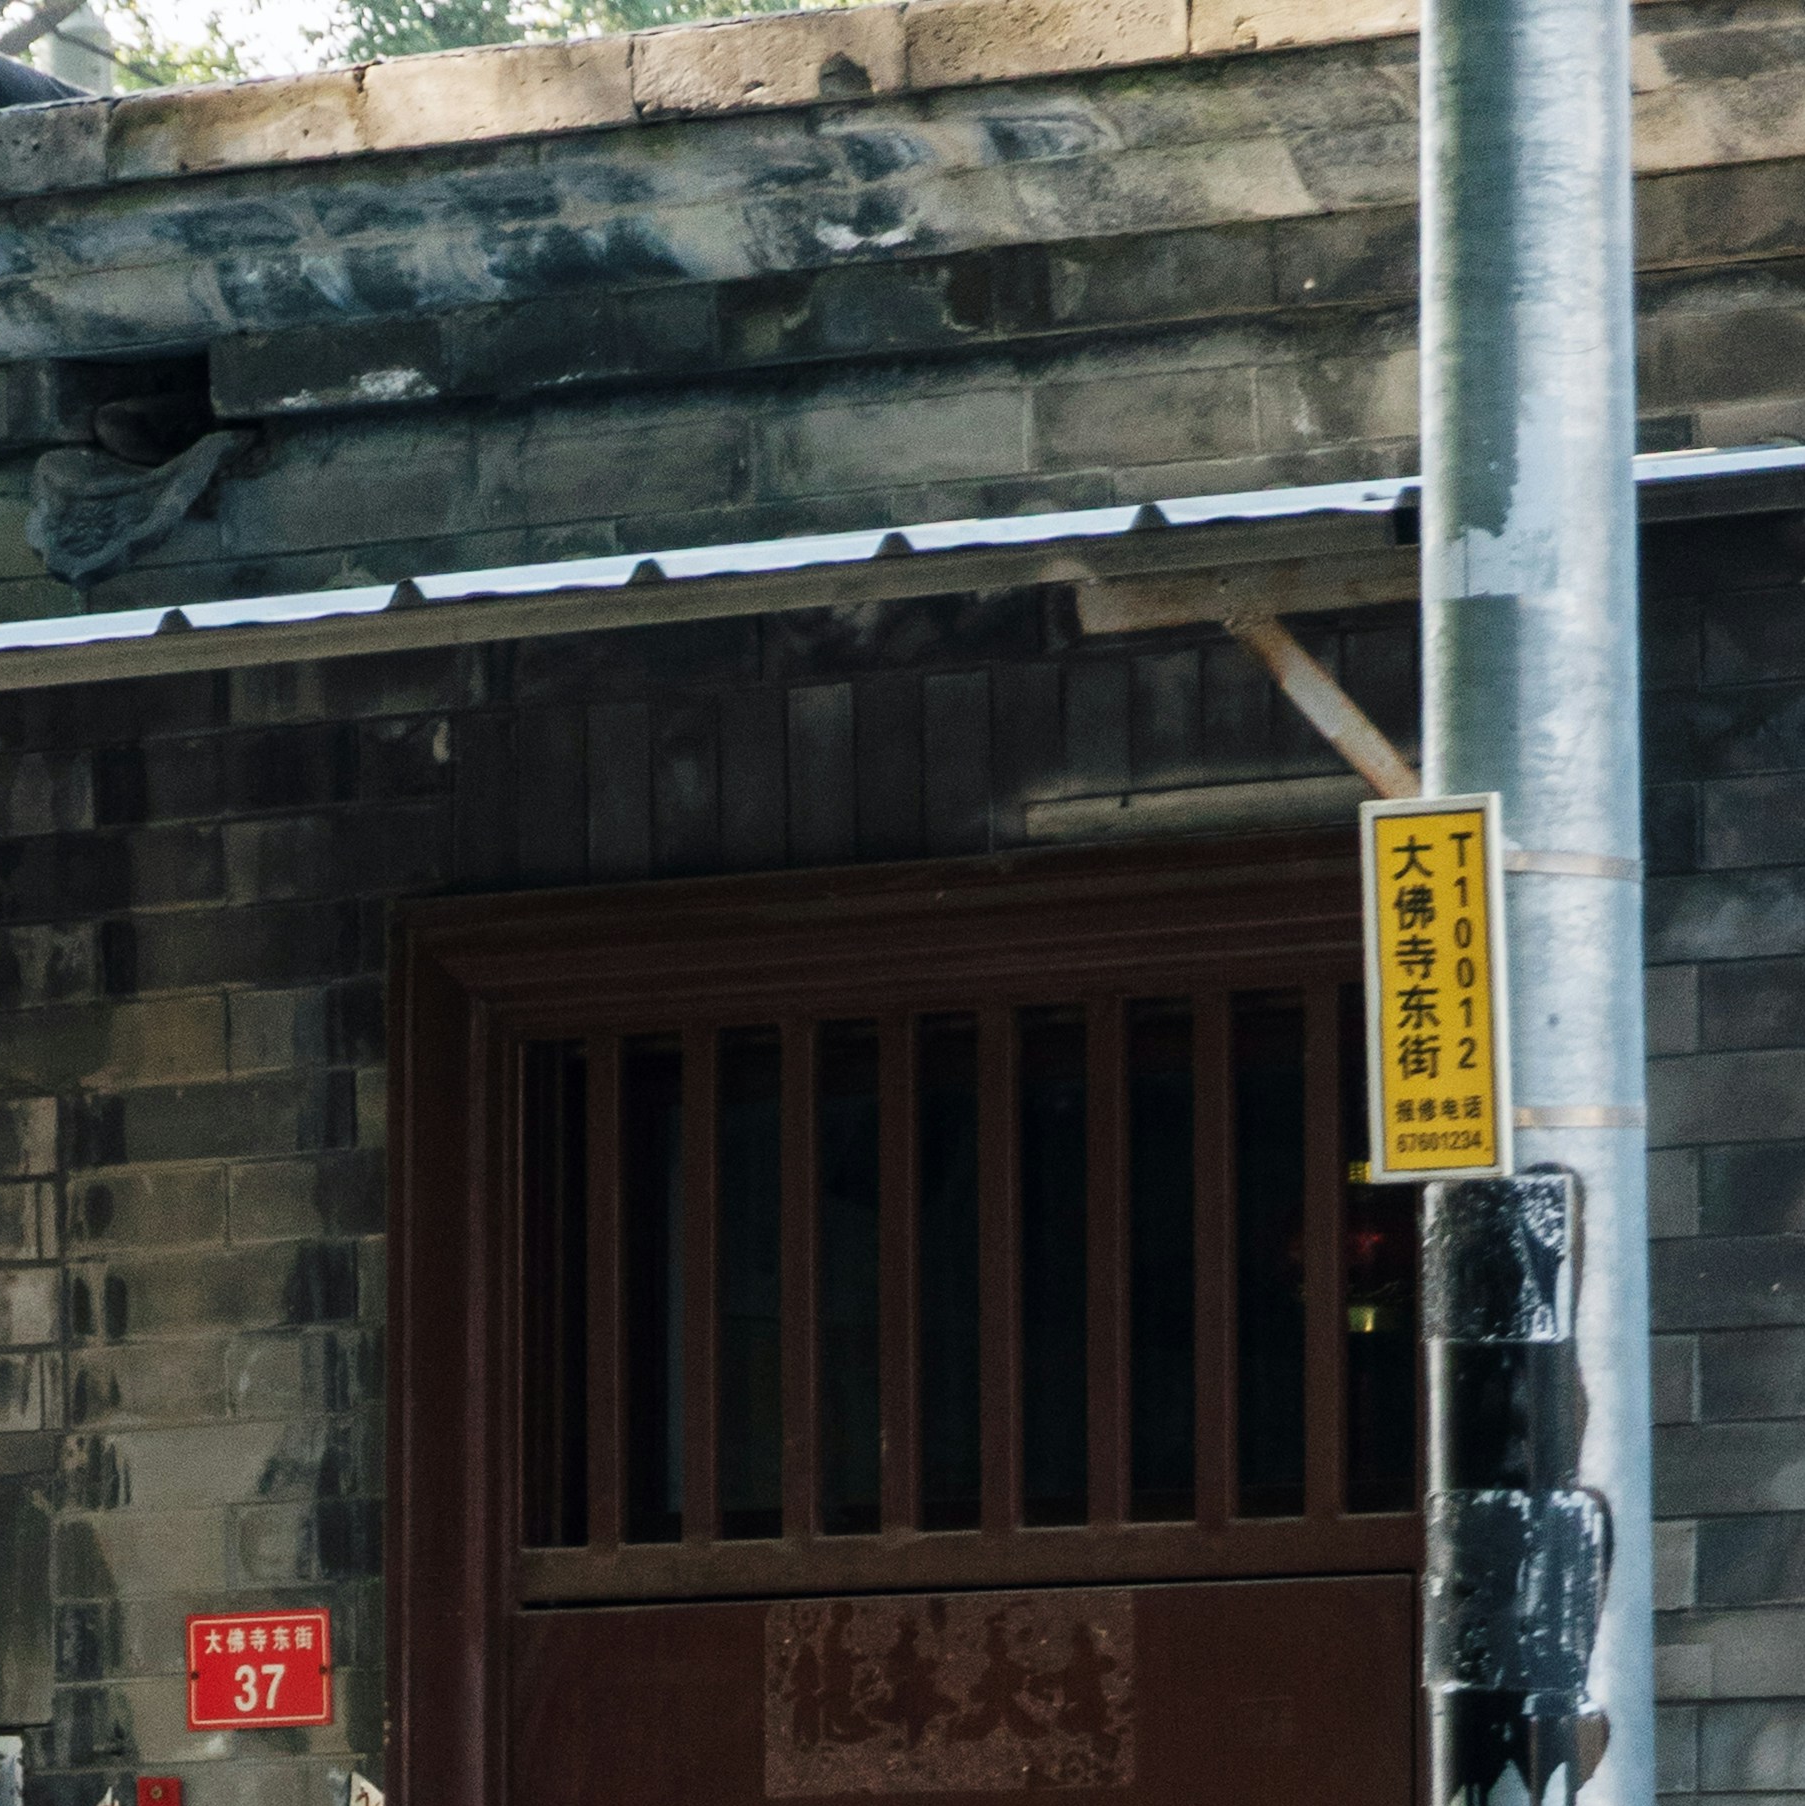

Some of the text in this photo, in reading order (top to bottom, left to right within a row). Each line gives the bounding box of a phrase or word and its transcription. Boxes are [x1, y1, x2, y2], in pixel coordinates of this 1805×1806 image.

[1392, 834, 1443, 1081] 大佛寺东街
[1448, 831, 1479, 1070] T10012
[204, 1625, 314, 1654] 大佛寺东街
[234, 1664, 286, 1712] 37
